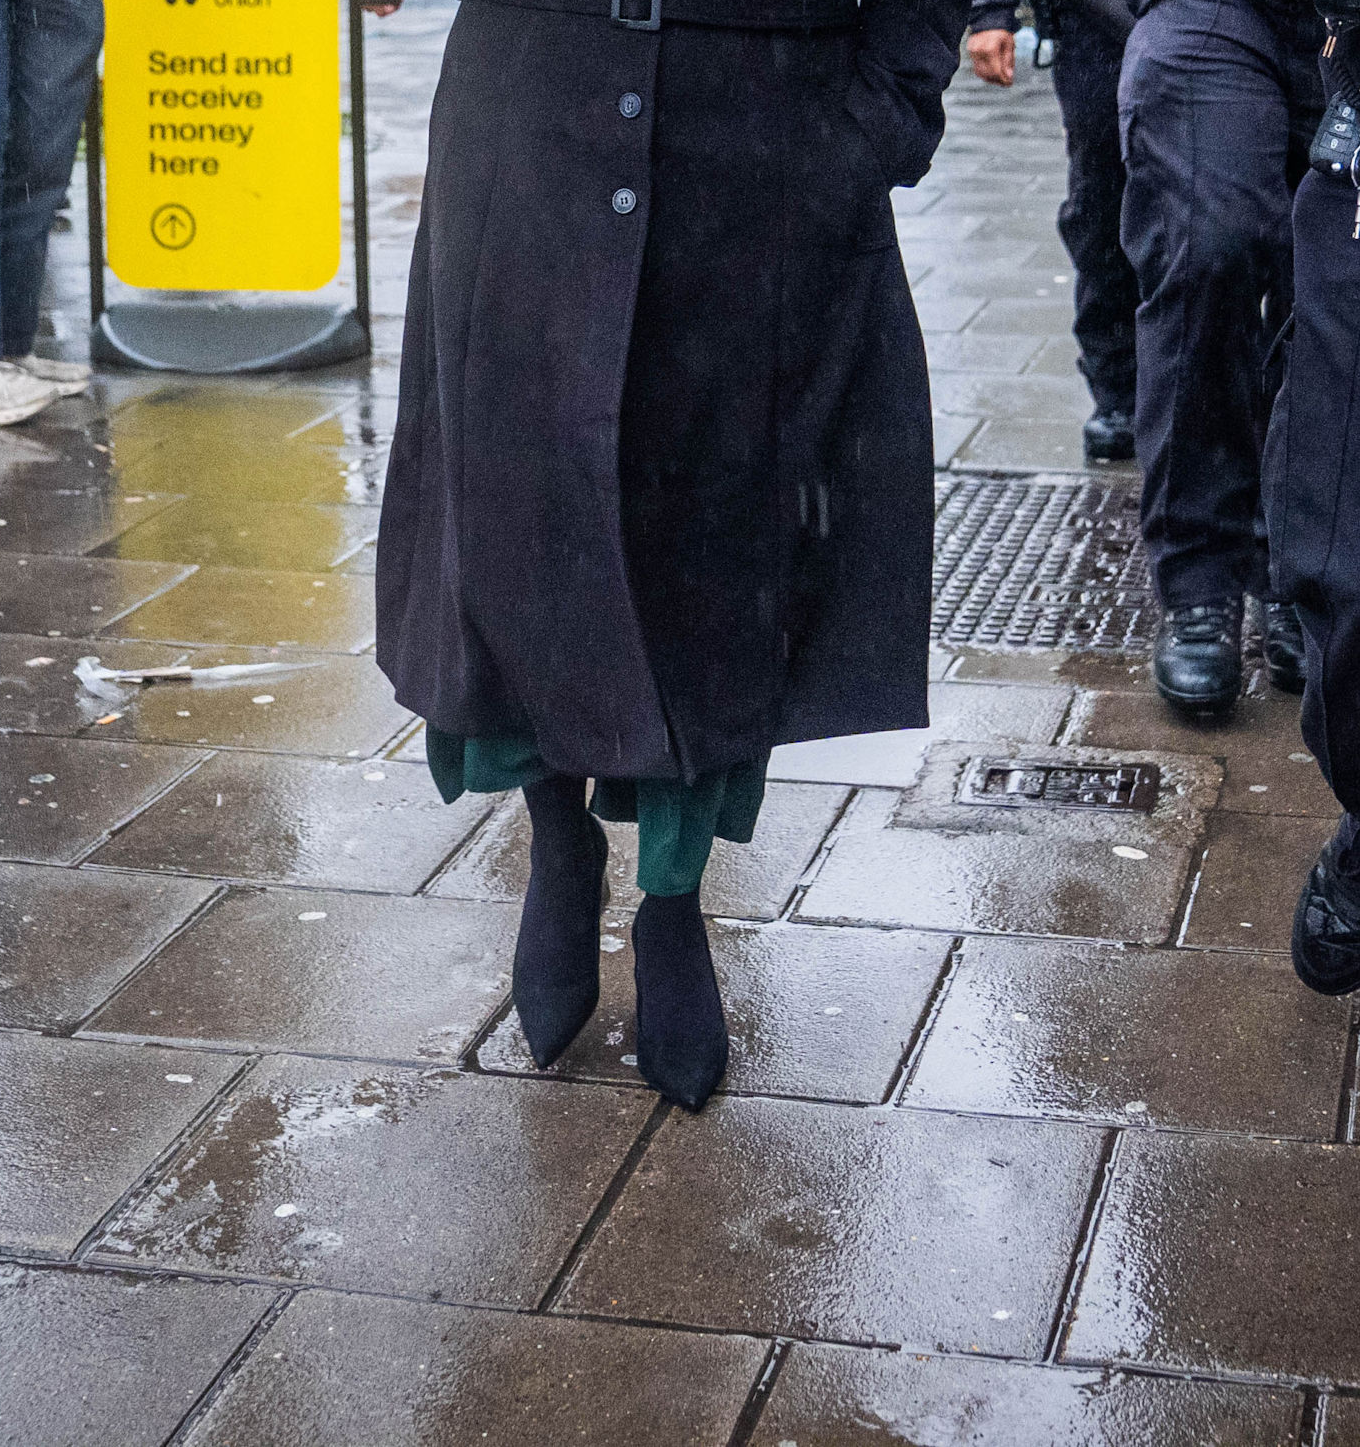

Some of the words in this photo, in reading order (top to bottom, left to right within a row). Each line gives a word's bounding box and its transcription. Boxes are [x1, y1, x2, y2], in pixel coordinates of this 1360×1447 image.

[148, 50, 227, 76] Send
[234, 52, 293, 76] and
[148, 85, 263, 110] receive
[148, 122, 254, 149] money
[148, 151, 220, 176] here
